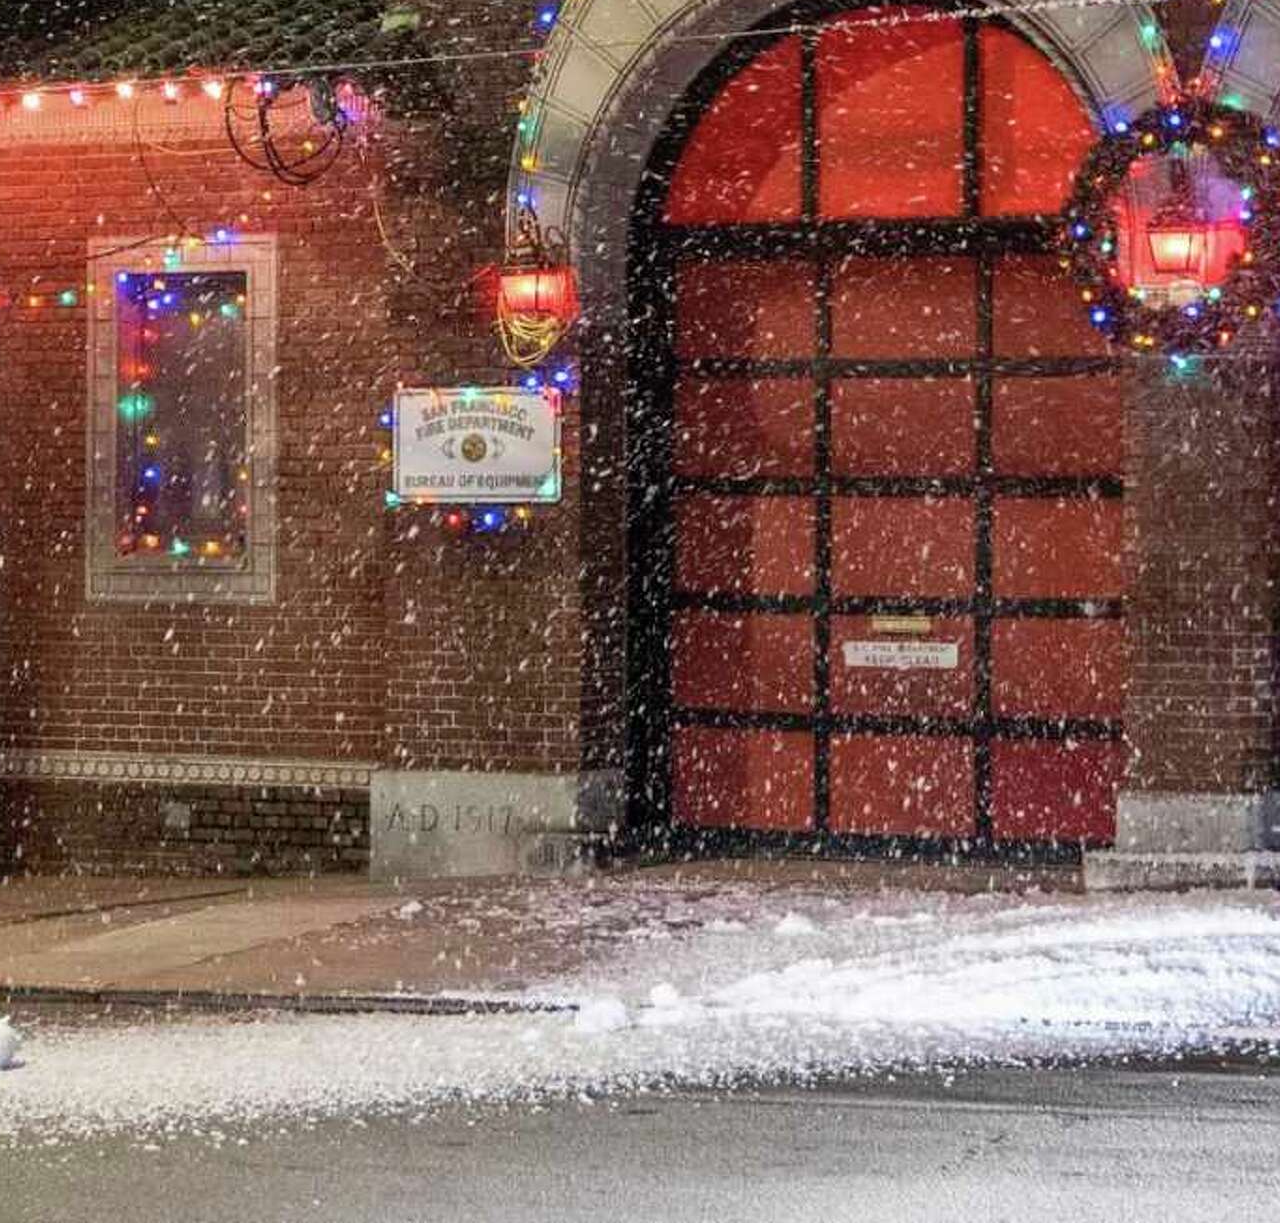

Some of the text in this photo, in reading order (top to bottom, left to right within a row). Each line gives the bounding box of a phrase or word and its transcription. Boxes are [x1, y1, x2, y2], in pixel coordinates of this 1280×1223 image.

[415, 415, 536, 442] FIRE DEPARTMENT
[405, 473, 455, 489] BUREAU
[458, 473, 475, 489] OF
